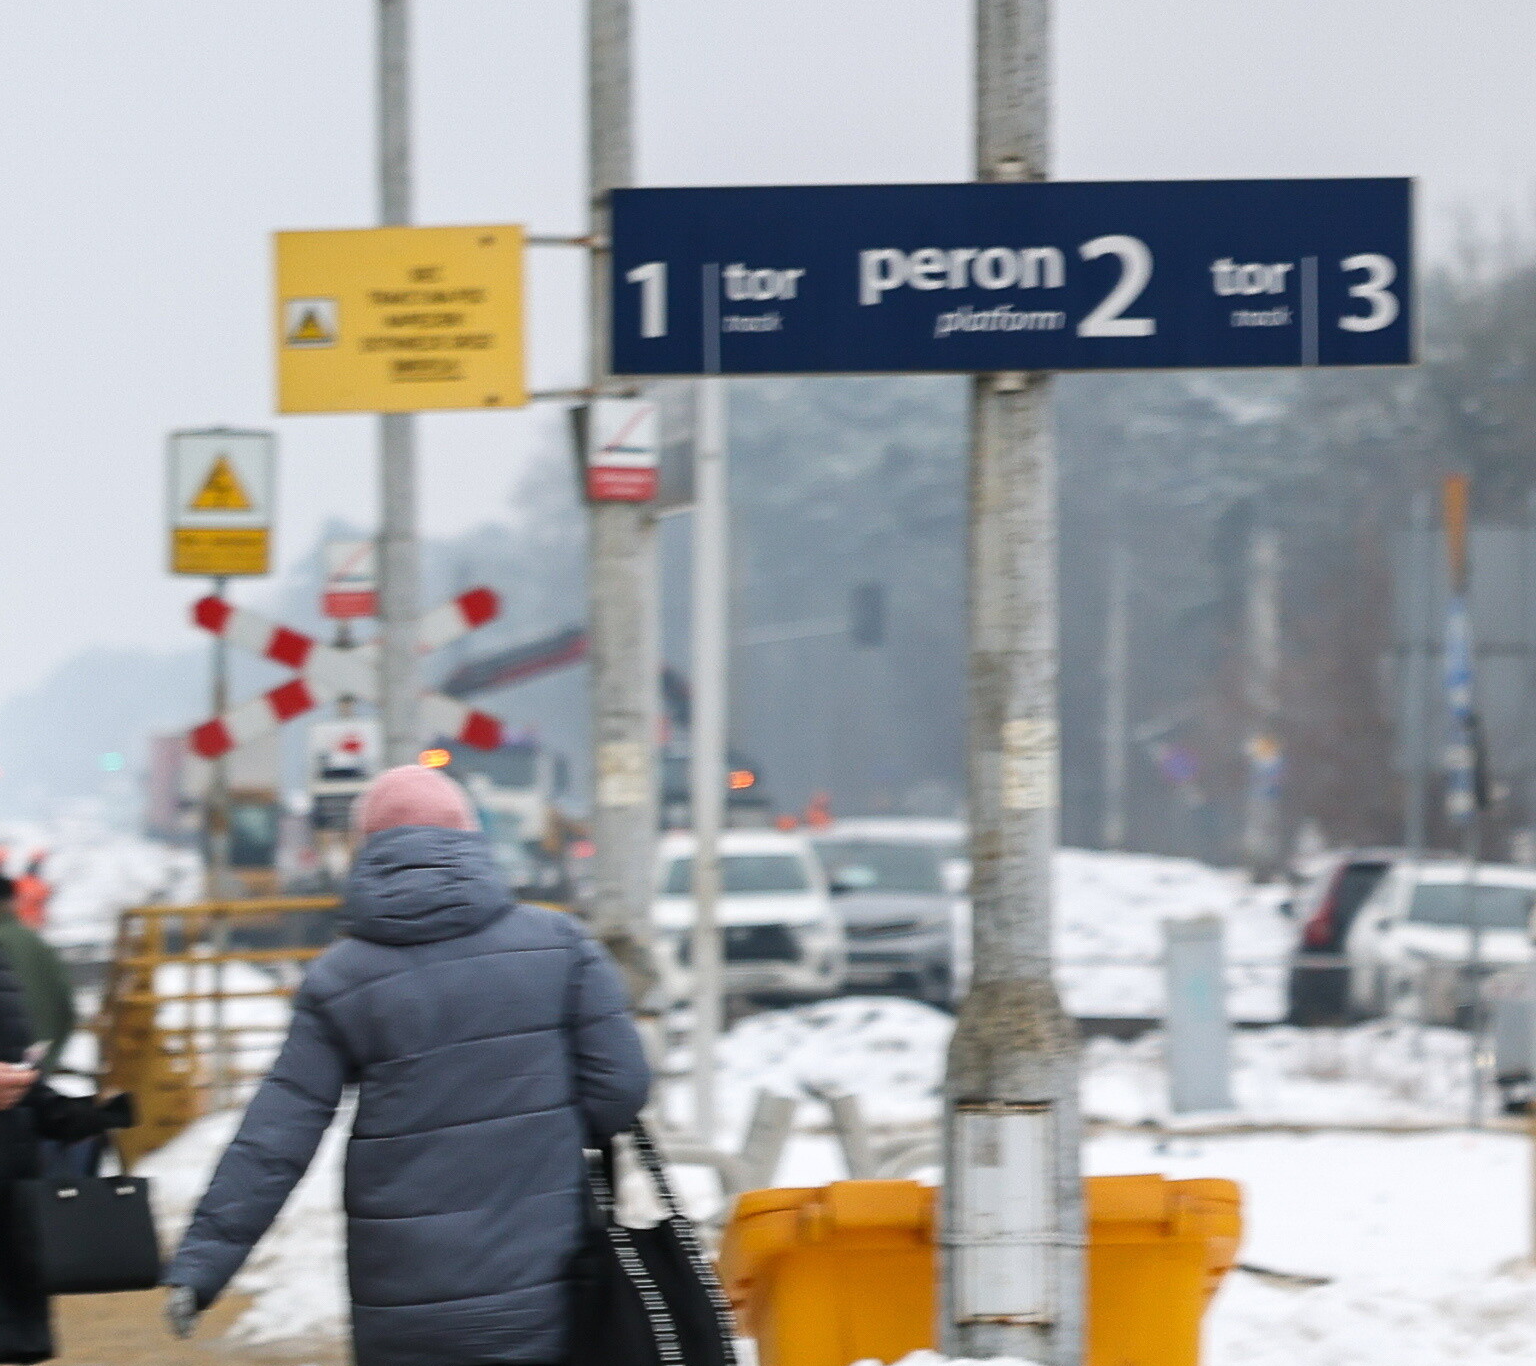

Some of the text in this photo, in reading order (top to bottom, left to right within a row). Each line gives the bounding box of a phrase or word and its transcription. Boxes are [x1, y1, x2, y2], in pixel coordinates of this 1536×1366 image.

[626, 261, 806, 338] 1 tor
[858, 234, 1158, 338] peron 2
[1209, 252, 1401, 333] tor 3
